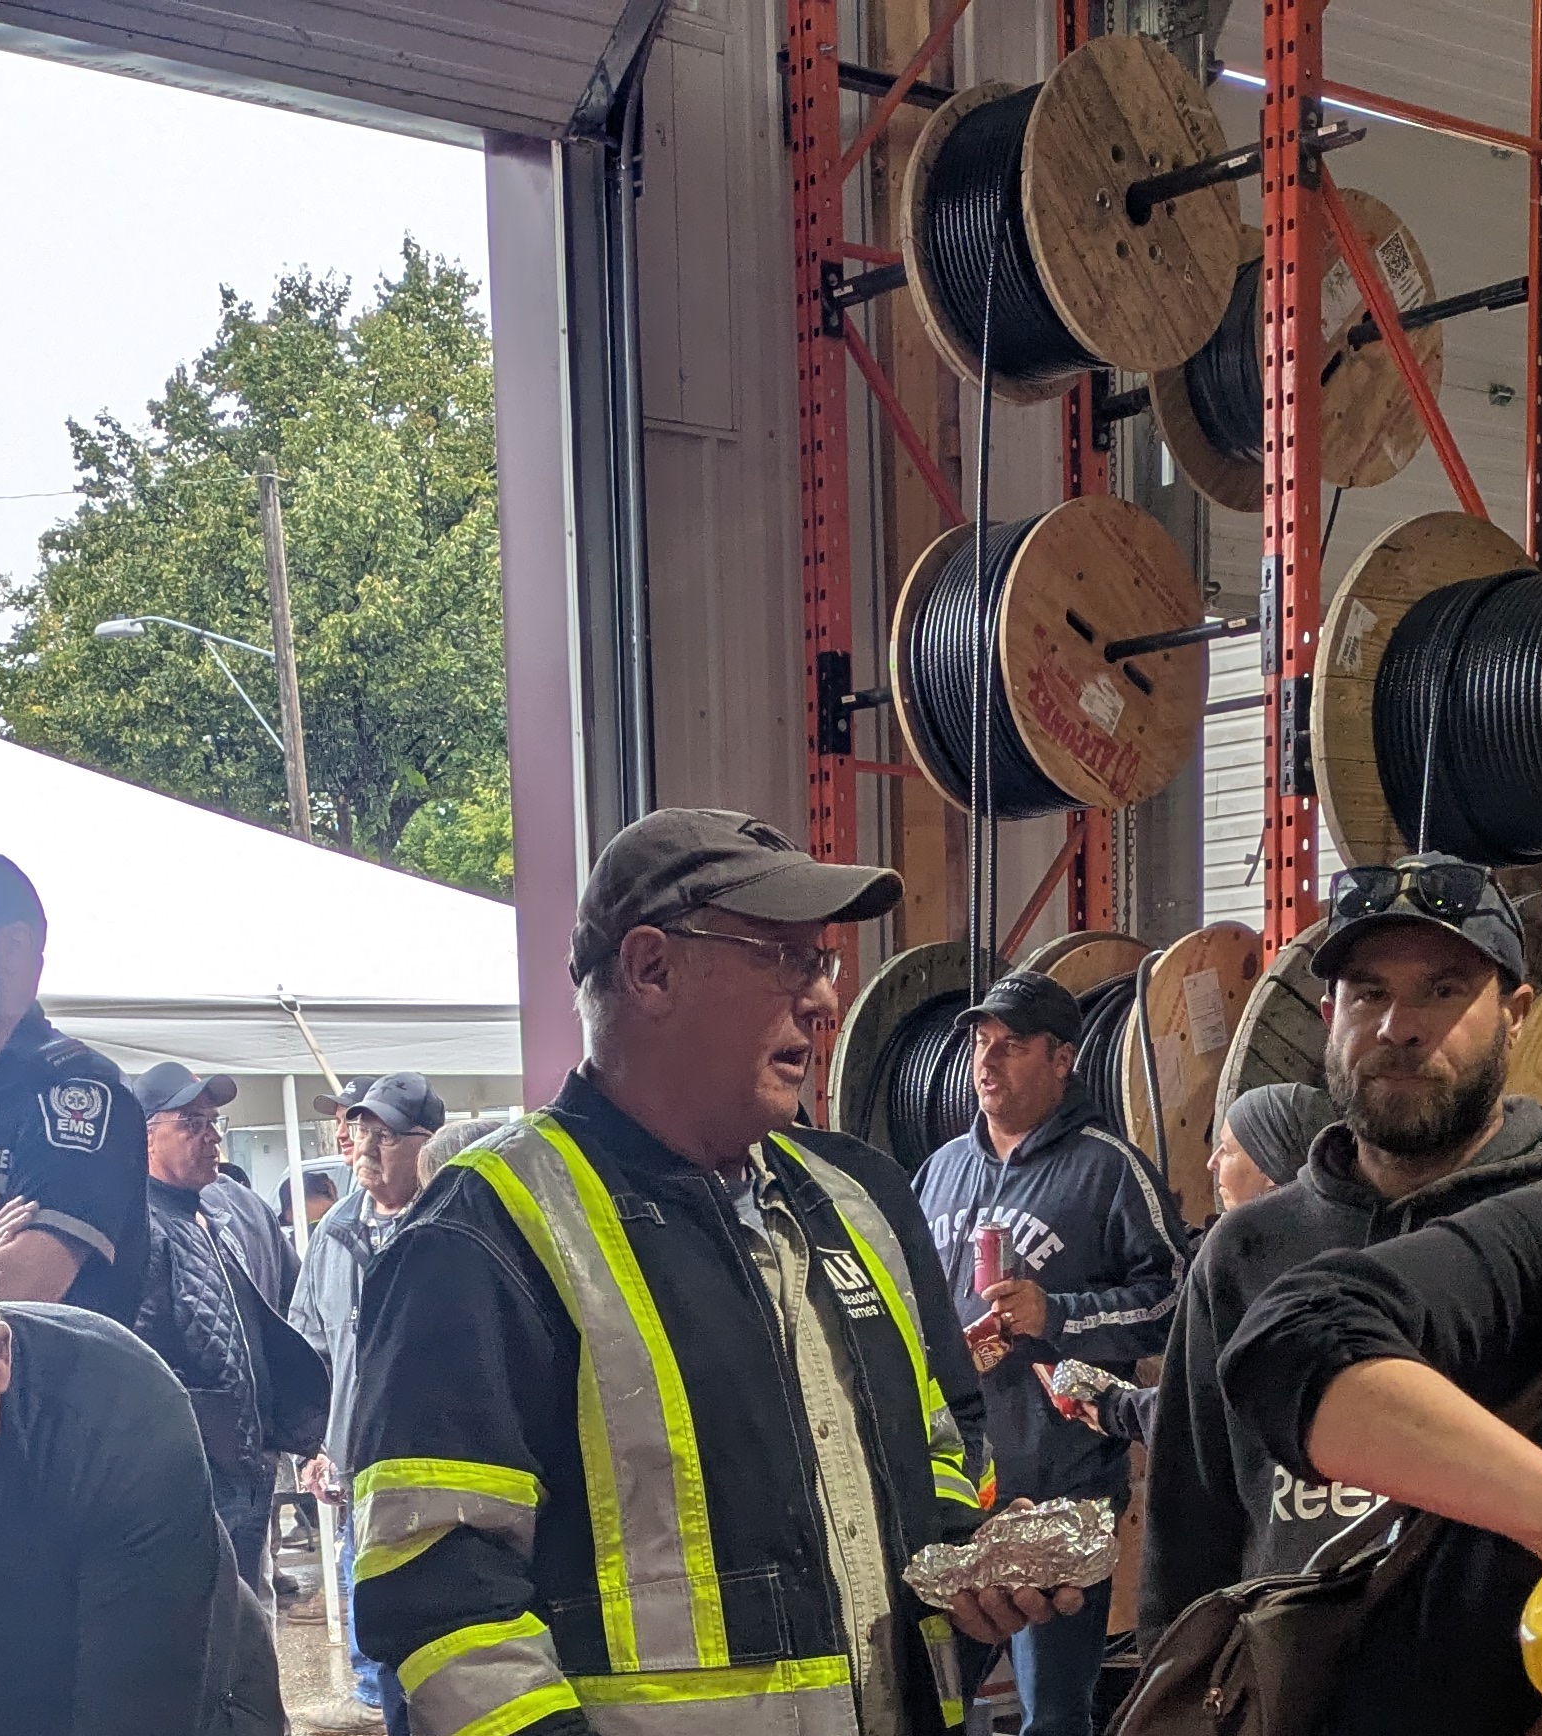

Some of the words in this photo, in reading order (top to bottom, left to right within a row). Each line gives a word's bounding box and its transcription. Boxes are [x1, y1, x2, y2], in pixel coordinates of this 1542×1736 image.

[56, 1117, 97, 1137] EMS
[928, 1205, 1066, 1271] OSEMITE
[1269, 1464, 1389, 1524] Ree
